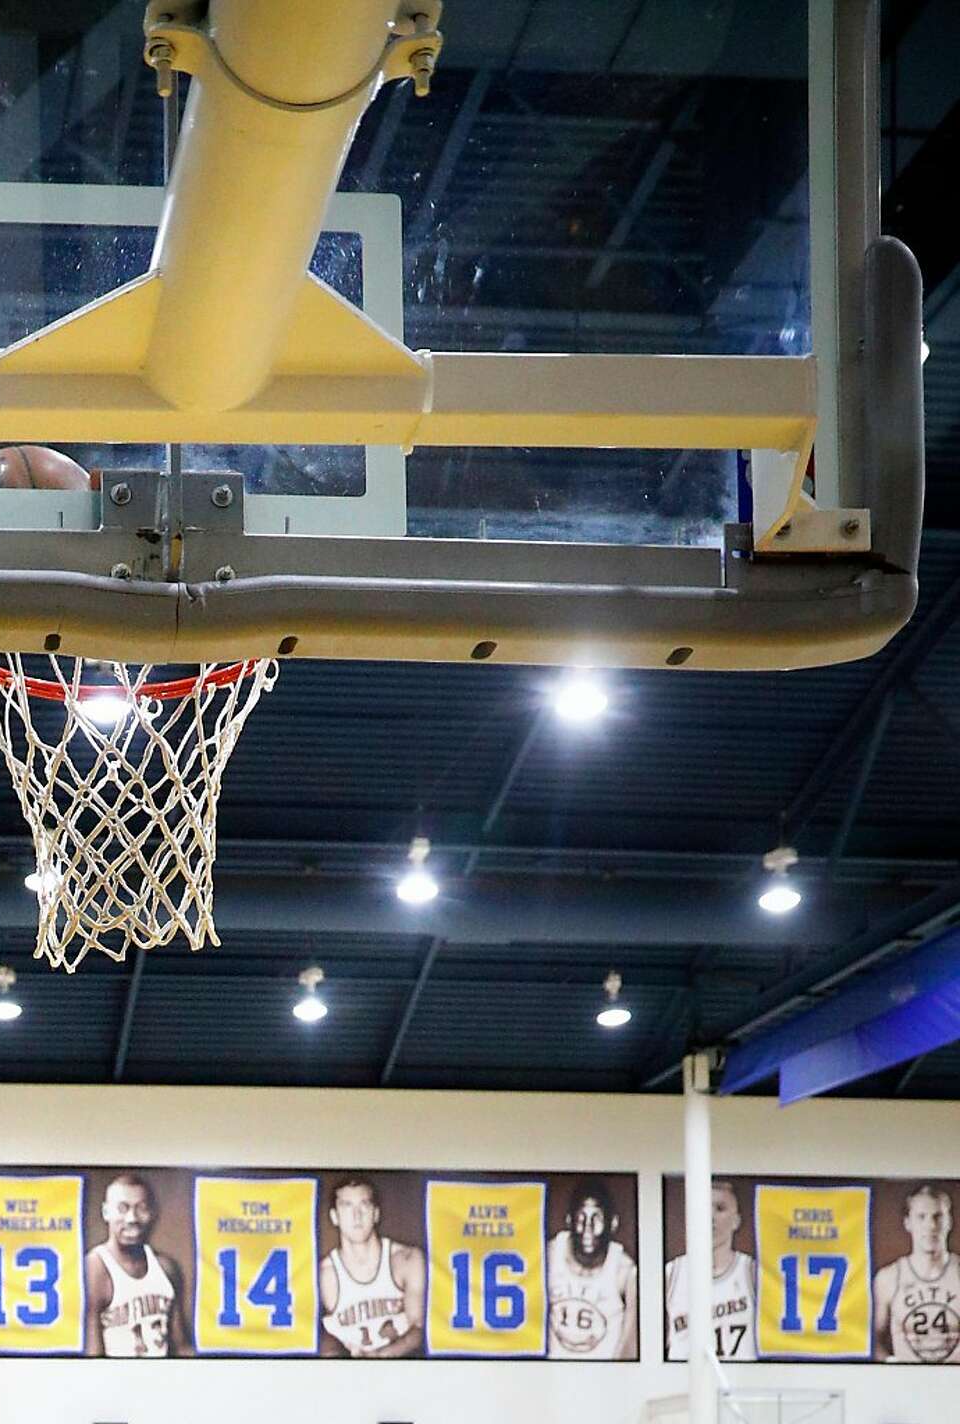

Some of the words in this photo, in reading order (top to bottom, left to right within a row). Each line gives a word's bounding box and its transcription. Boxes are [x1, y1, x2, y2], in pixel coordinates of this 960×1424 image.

[4, 1199, 39, 1213] WILT
[241, 1201, 270, 1215] TOM
[468, 1205, 508, 1220] ALVIN
[218, 1248, 293, 1327] 14
[451, 1251, 525, 1329] 16
[780, 1255, 848, 1332] 17
[904, 1286, 957, 1308] CITY
[560, 1306, 594, 1330] 16
[913, 1310, 950, 1335] 24
[715, 1324, 747, 1356] 17
